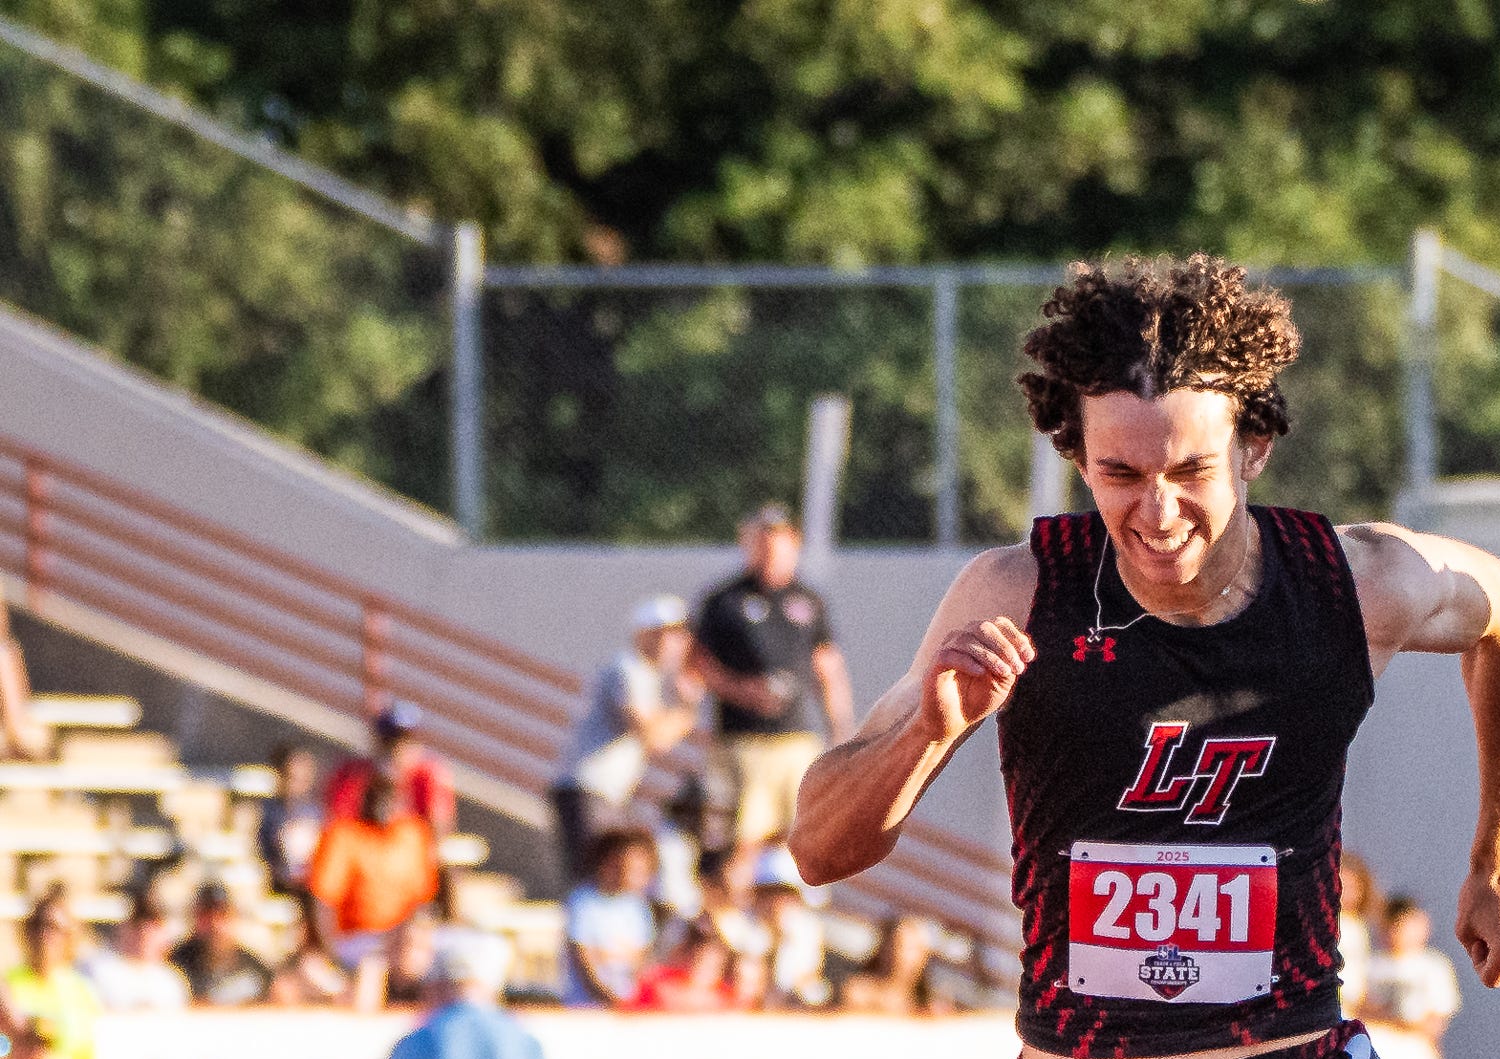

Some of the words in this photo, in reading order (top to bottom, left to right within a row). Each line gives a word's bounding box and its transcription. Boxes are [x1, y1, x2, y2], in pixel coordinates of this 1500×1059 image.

[1116, 721, 1277, 825] LT
[1156, 850, 1190, 862] 2025
[1092, 870, 1250, 943] 2341
[1139, 965, 1199, 981] STATE
